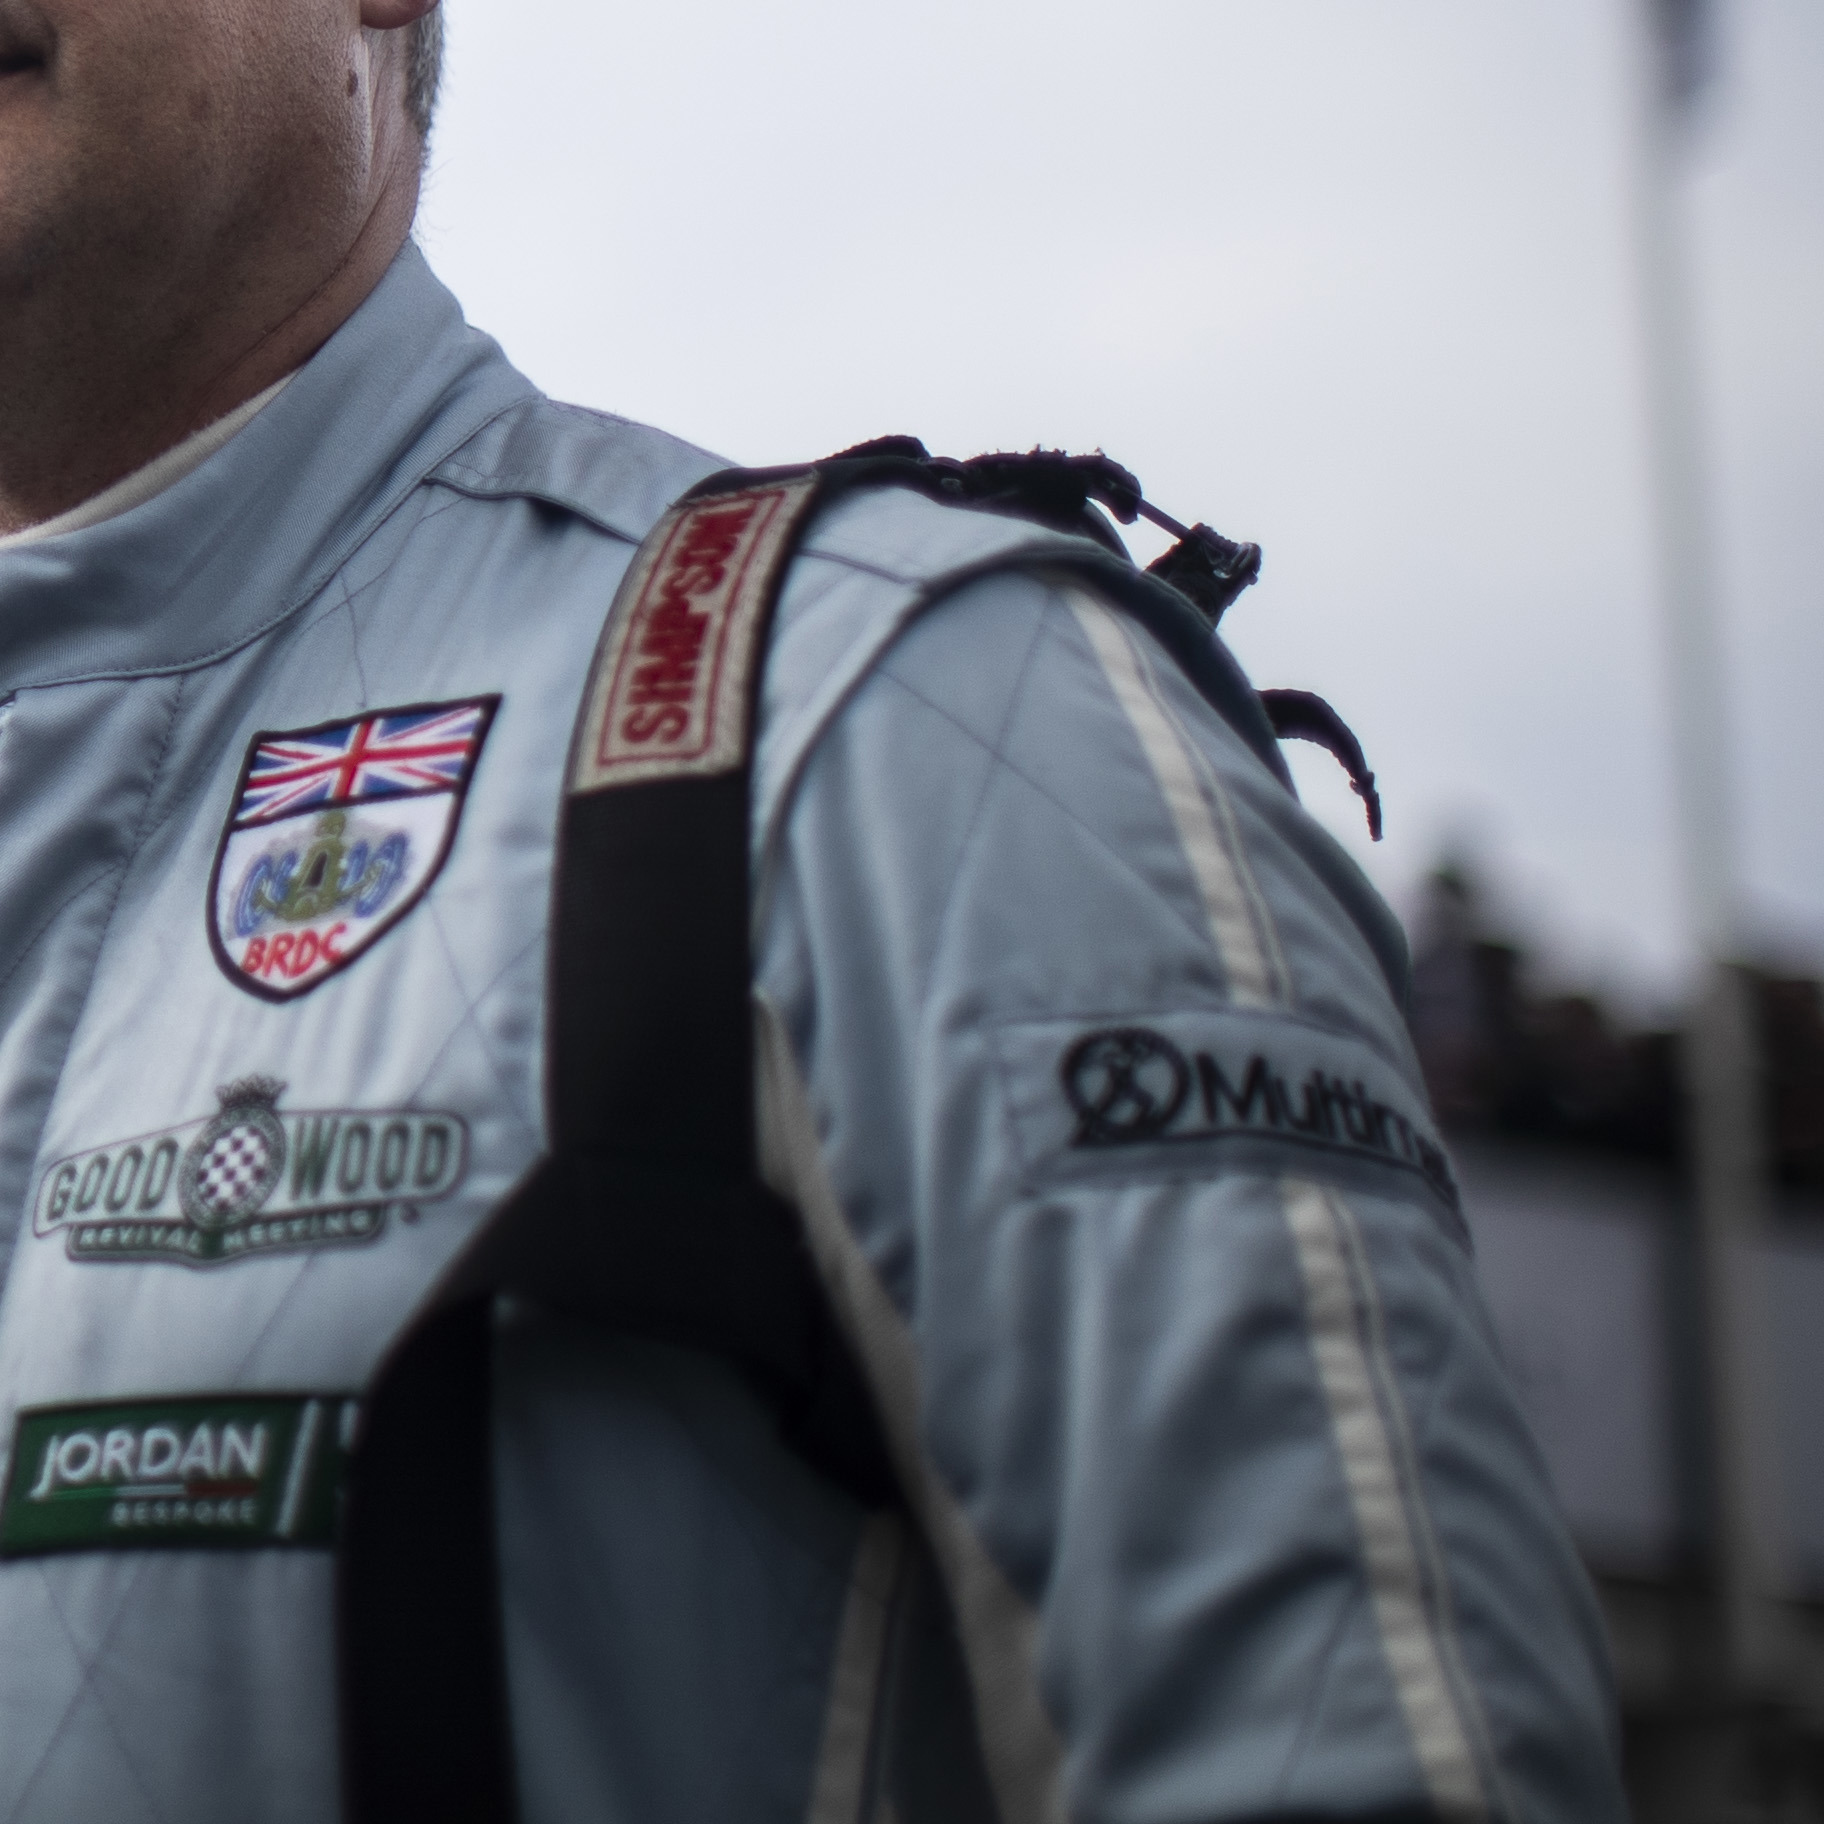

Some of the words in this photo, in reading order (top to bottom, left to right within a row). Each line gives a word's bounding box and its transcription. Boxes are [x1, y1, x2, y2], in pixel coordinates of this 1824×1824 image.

[621, 505, 756, 743] SIMPSON
[240, 922, 347, 977] BRDC
[47, 1137, 179, 1223] GOOD
[289, 1116, 450, 1201] WOOD
[29, 1421, 268, 1502] JORDAN
[110, 1498, 258, 1528] BESPOKE
